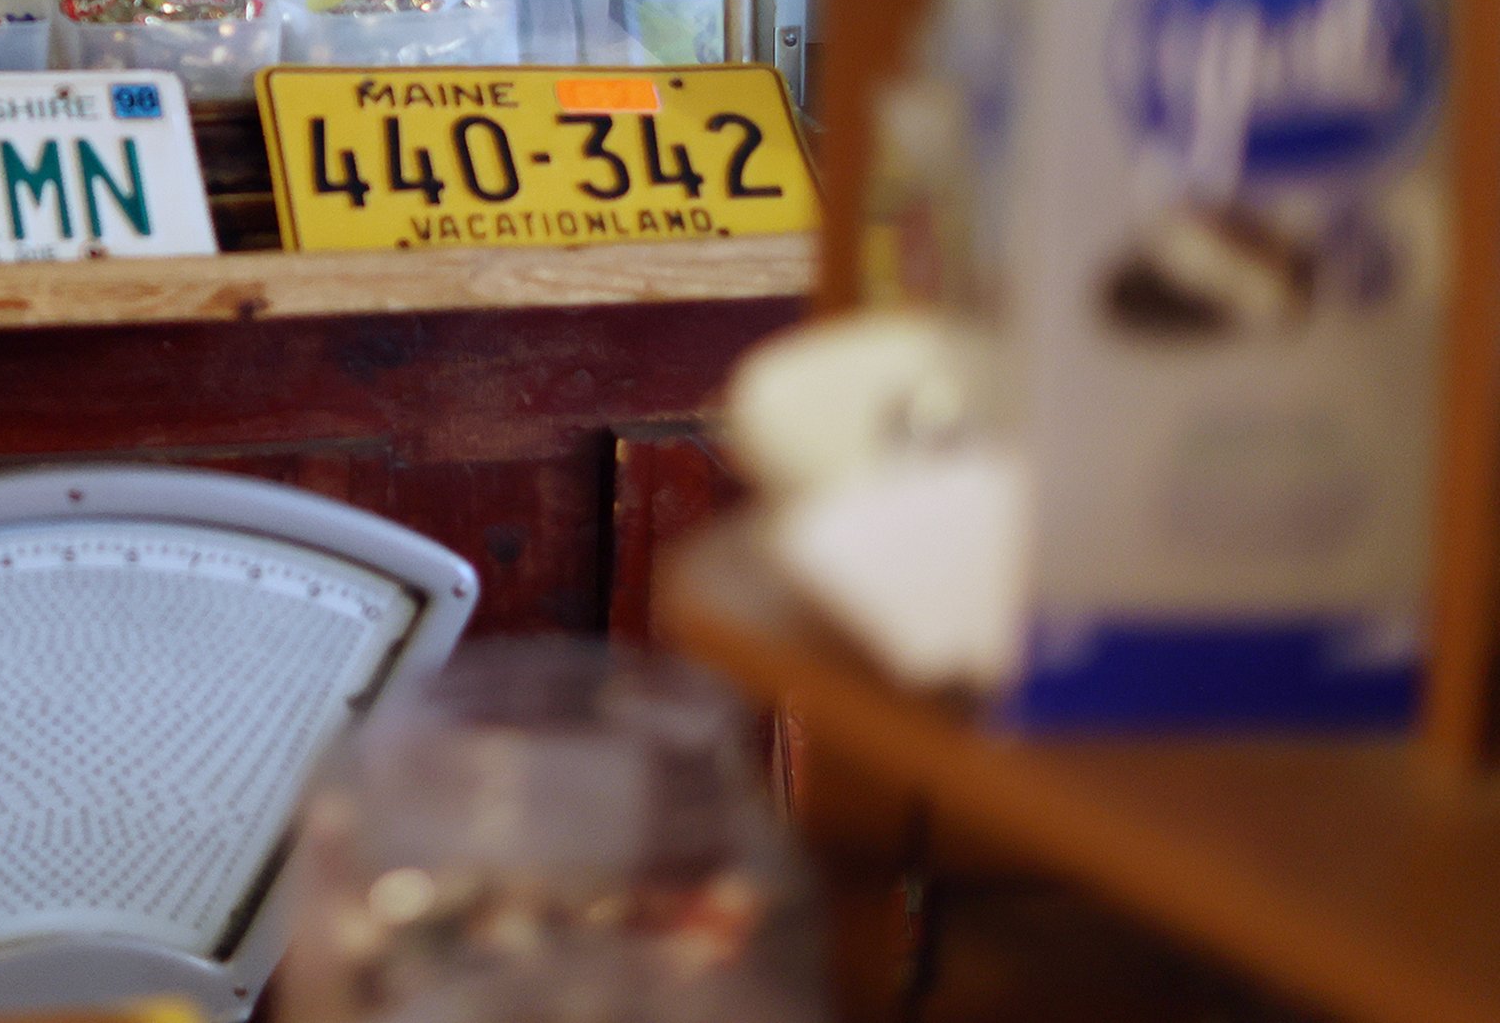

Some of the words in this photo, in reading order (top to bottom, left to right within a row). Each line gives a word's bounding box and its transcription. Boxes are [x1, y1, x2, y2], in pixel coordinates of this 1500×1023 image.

[357, 79, 520, 111] MAINE
[309, 111, 785, 209] 440-342
[410, 207, 715, 242] VACATIONLAND
